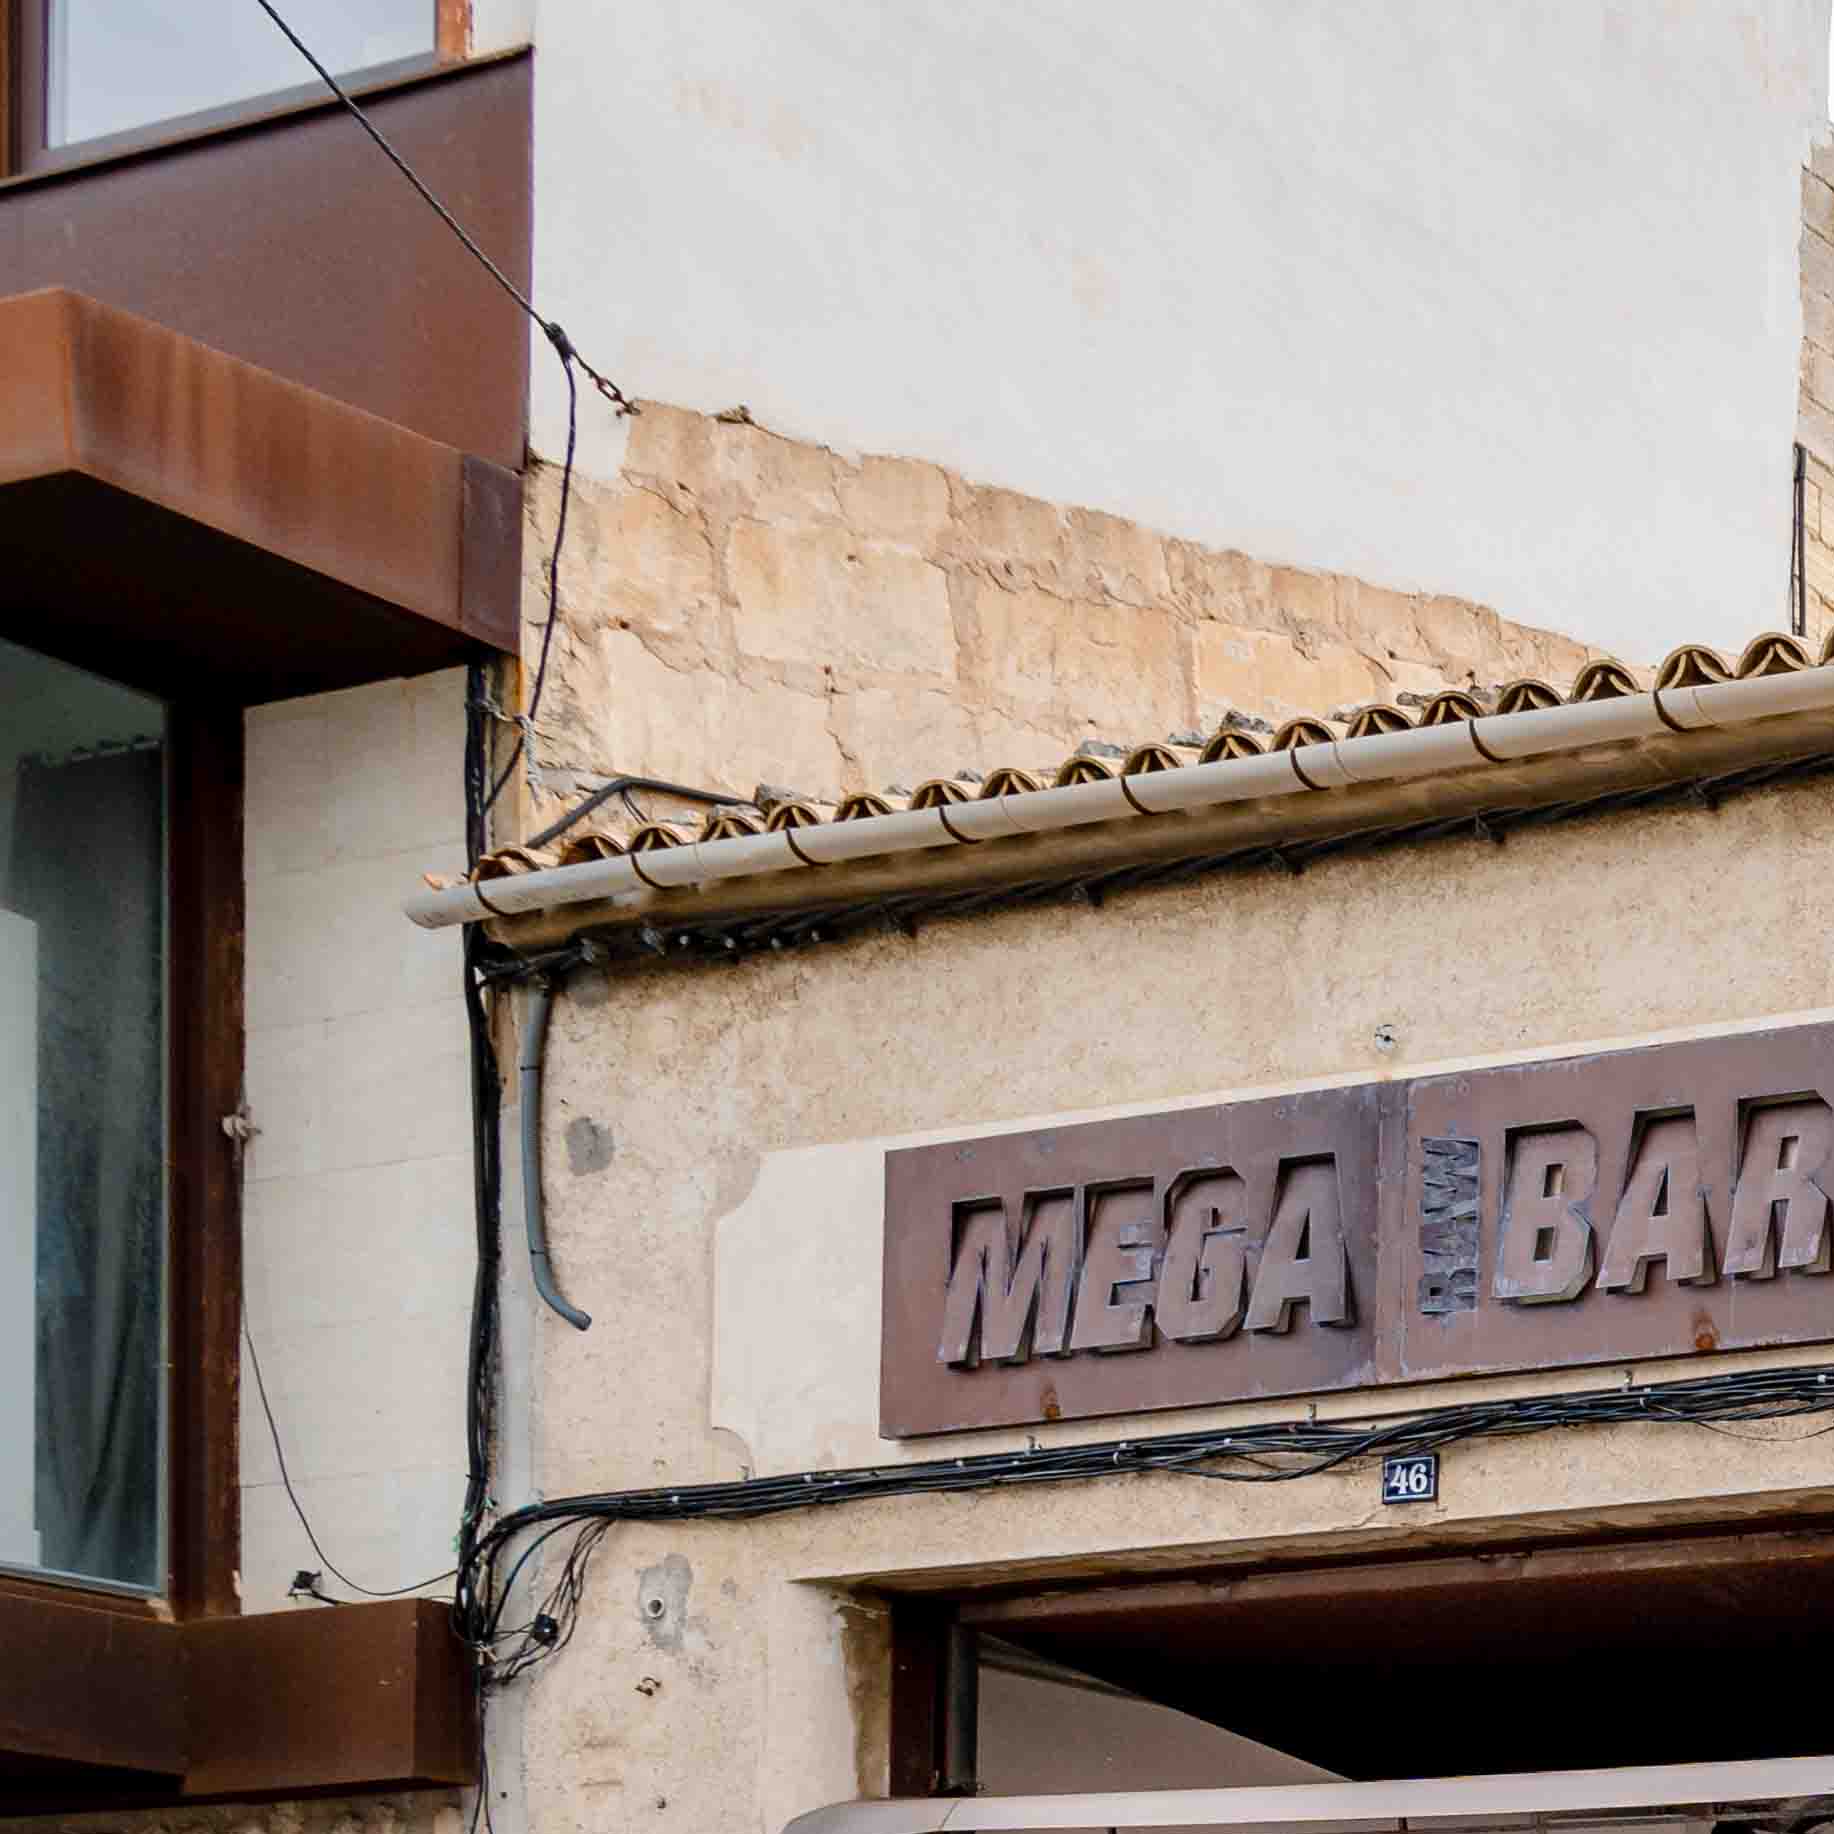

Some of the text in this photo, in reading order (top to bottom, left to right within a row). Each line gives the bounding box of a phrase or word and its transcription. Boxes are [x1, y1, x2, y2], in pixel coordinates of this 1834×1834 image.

[936, 1152, 1358, 1370] MEGA
[1420, 1136, 1480, 1316] RAW
[1390, 1463, 1428, 1495] 46
